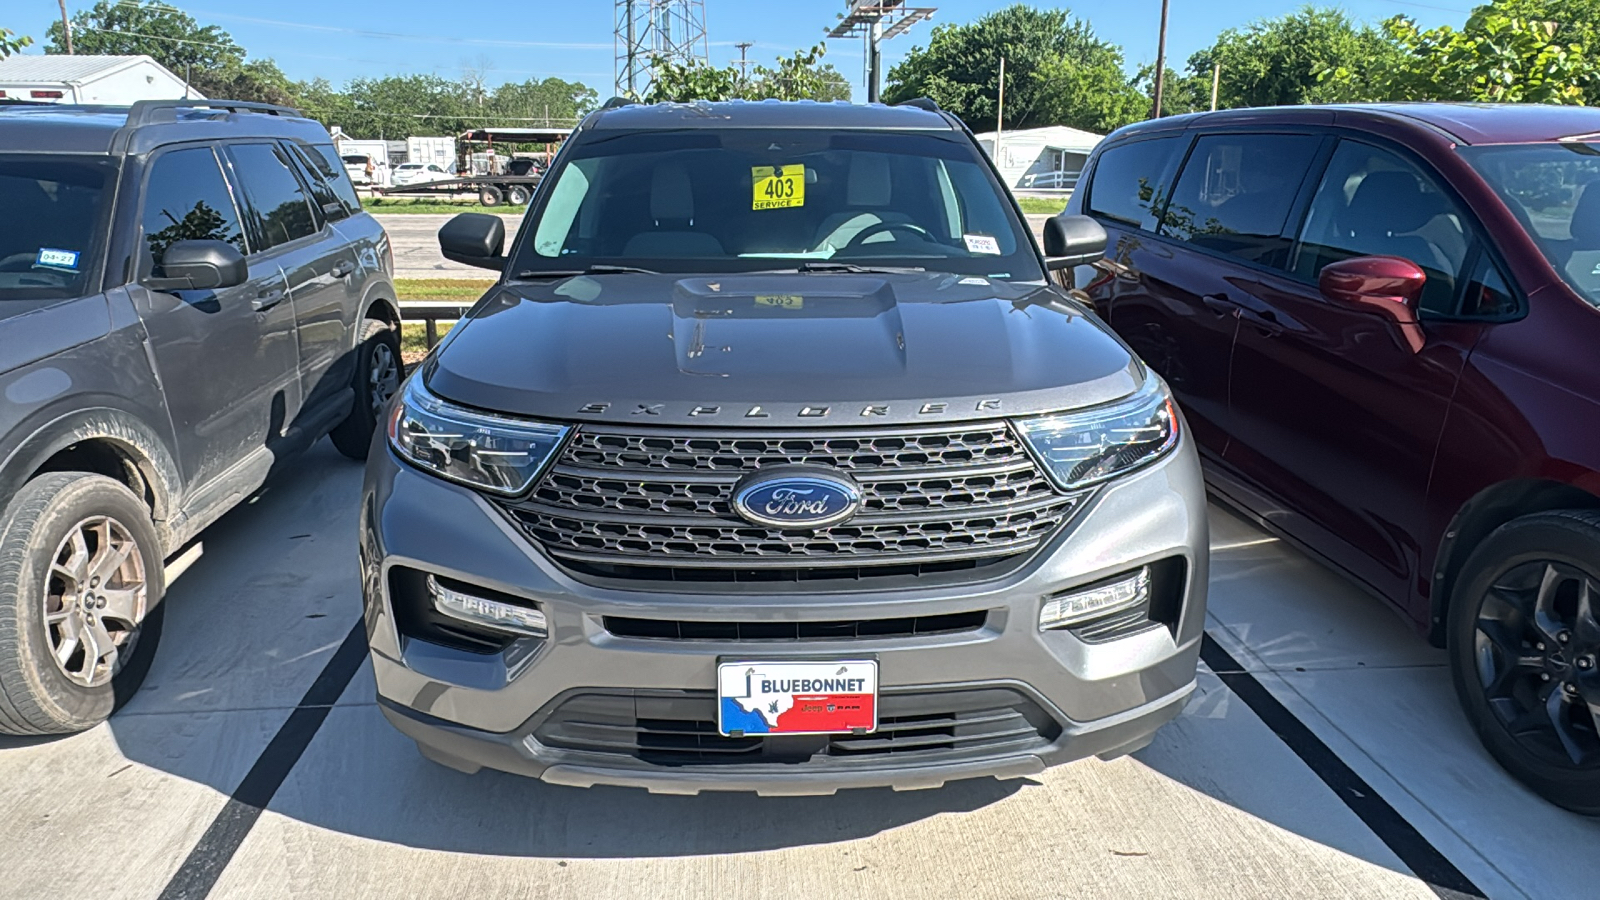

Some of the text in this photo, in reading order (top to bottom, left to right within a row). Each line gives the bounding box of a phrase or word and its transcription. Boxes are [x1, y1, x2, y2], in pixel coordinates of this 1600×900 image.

[765, 178, 794, 198] 403
[754, 200, 792, 209] SERVICE
[577, 399, 1001, 417] EXPLORER
[765, 488, 830, 515] Ford
[761, 678, 865, 693] BLUEBONNET
[801, 704, 823, 712] Jeep
